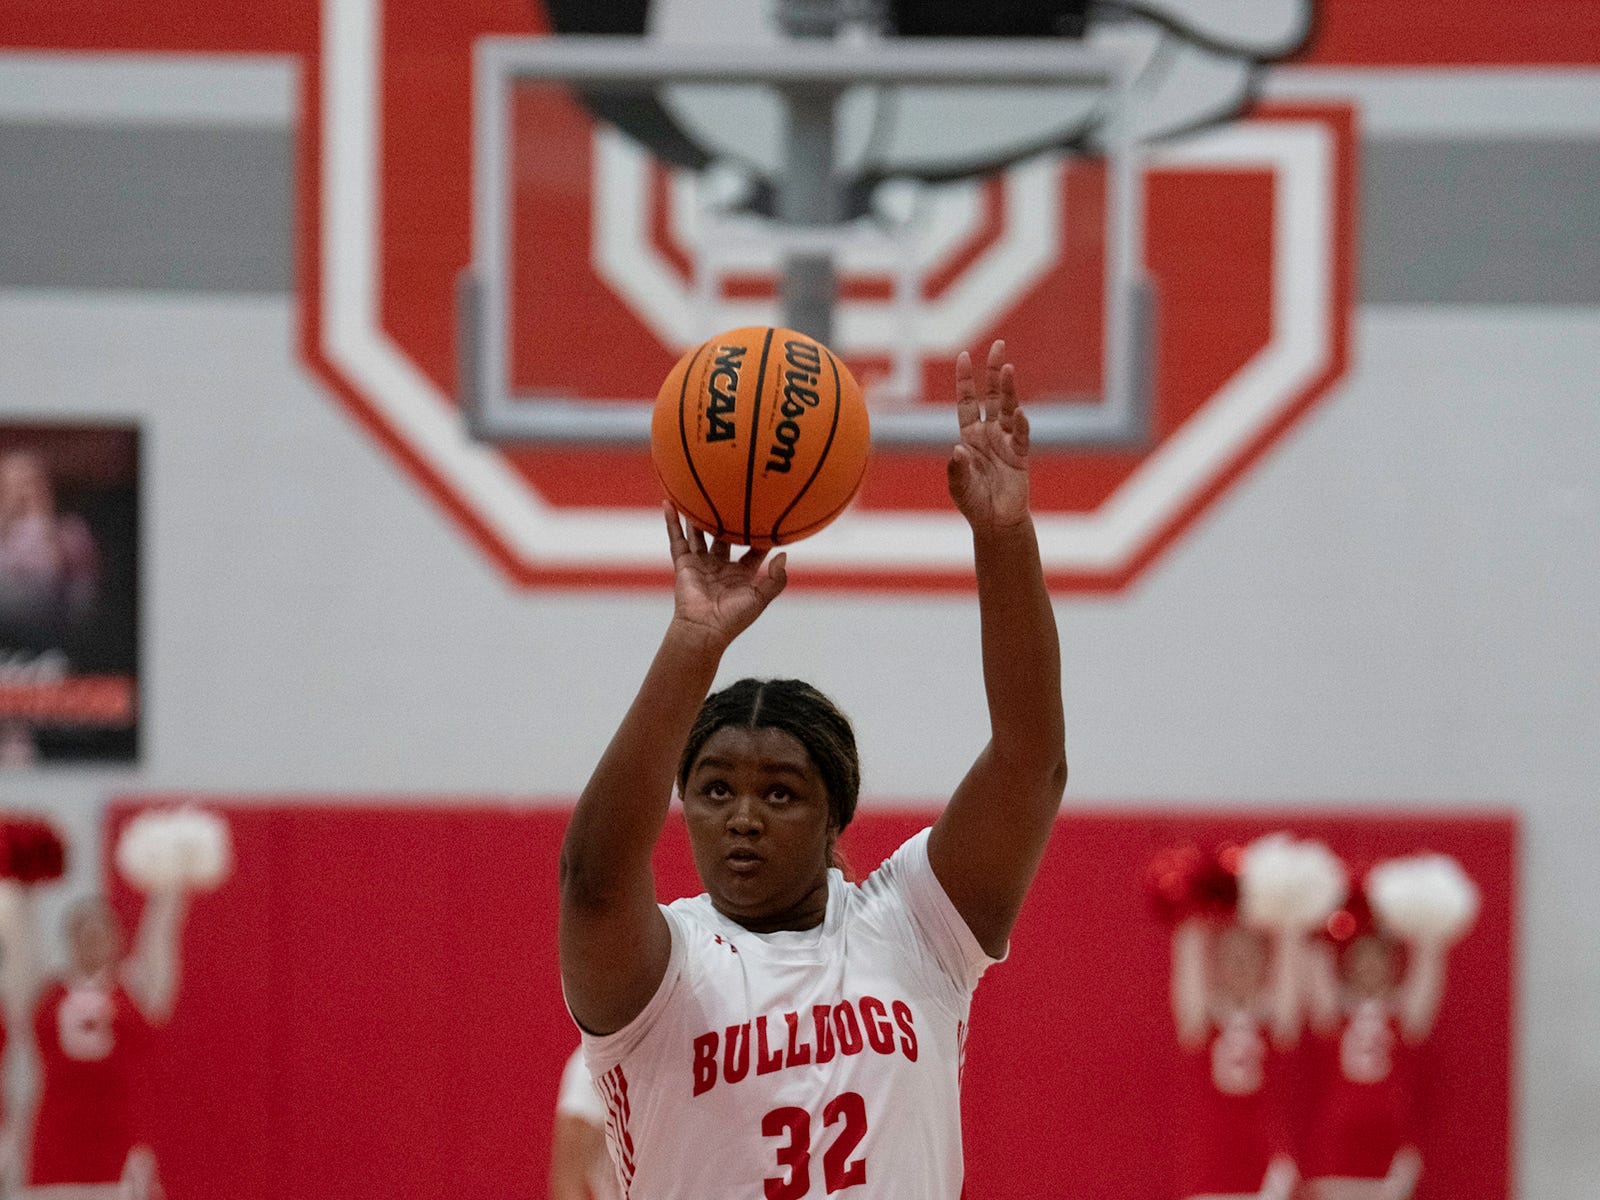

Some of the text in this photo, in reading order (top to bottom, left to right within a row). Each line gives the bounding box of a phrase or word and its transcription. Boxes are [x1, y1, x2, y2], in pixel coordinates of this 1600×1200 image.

[706, 346, 747, 443] NCAA
[764, 340, 821, 474] Wilson
[692, 995, 919, 1098] BULLDOGS
